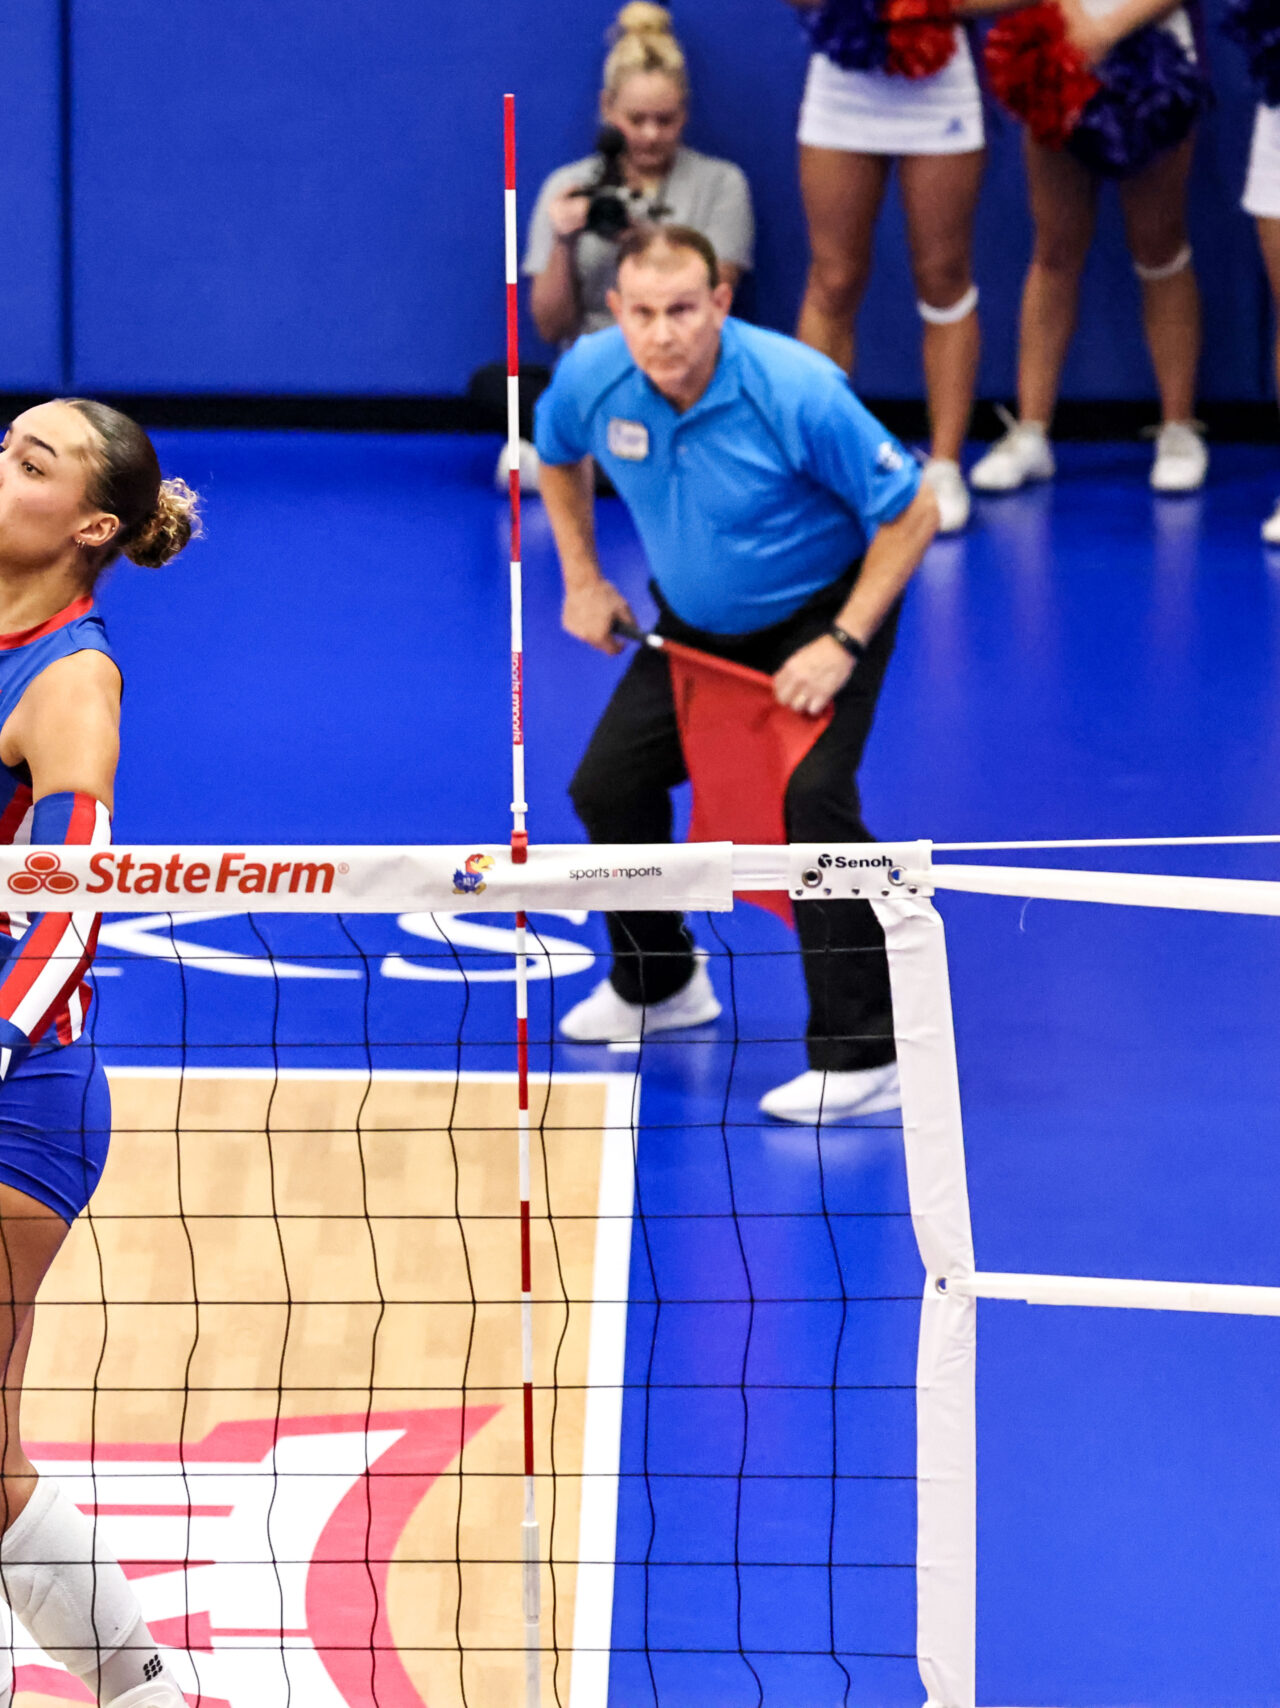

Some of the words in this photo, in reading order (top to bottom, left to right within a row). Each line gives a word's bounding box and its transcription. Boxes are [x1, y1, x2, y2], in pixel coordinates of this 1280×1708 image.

[834, 855, 894, 869] Senoh
[568, 866, 610, 881] sports
[611, 865, 663, 879] imports
